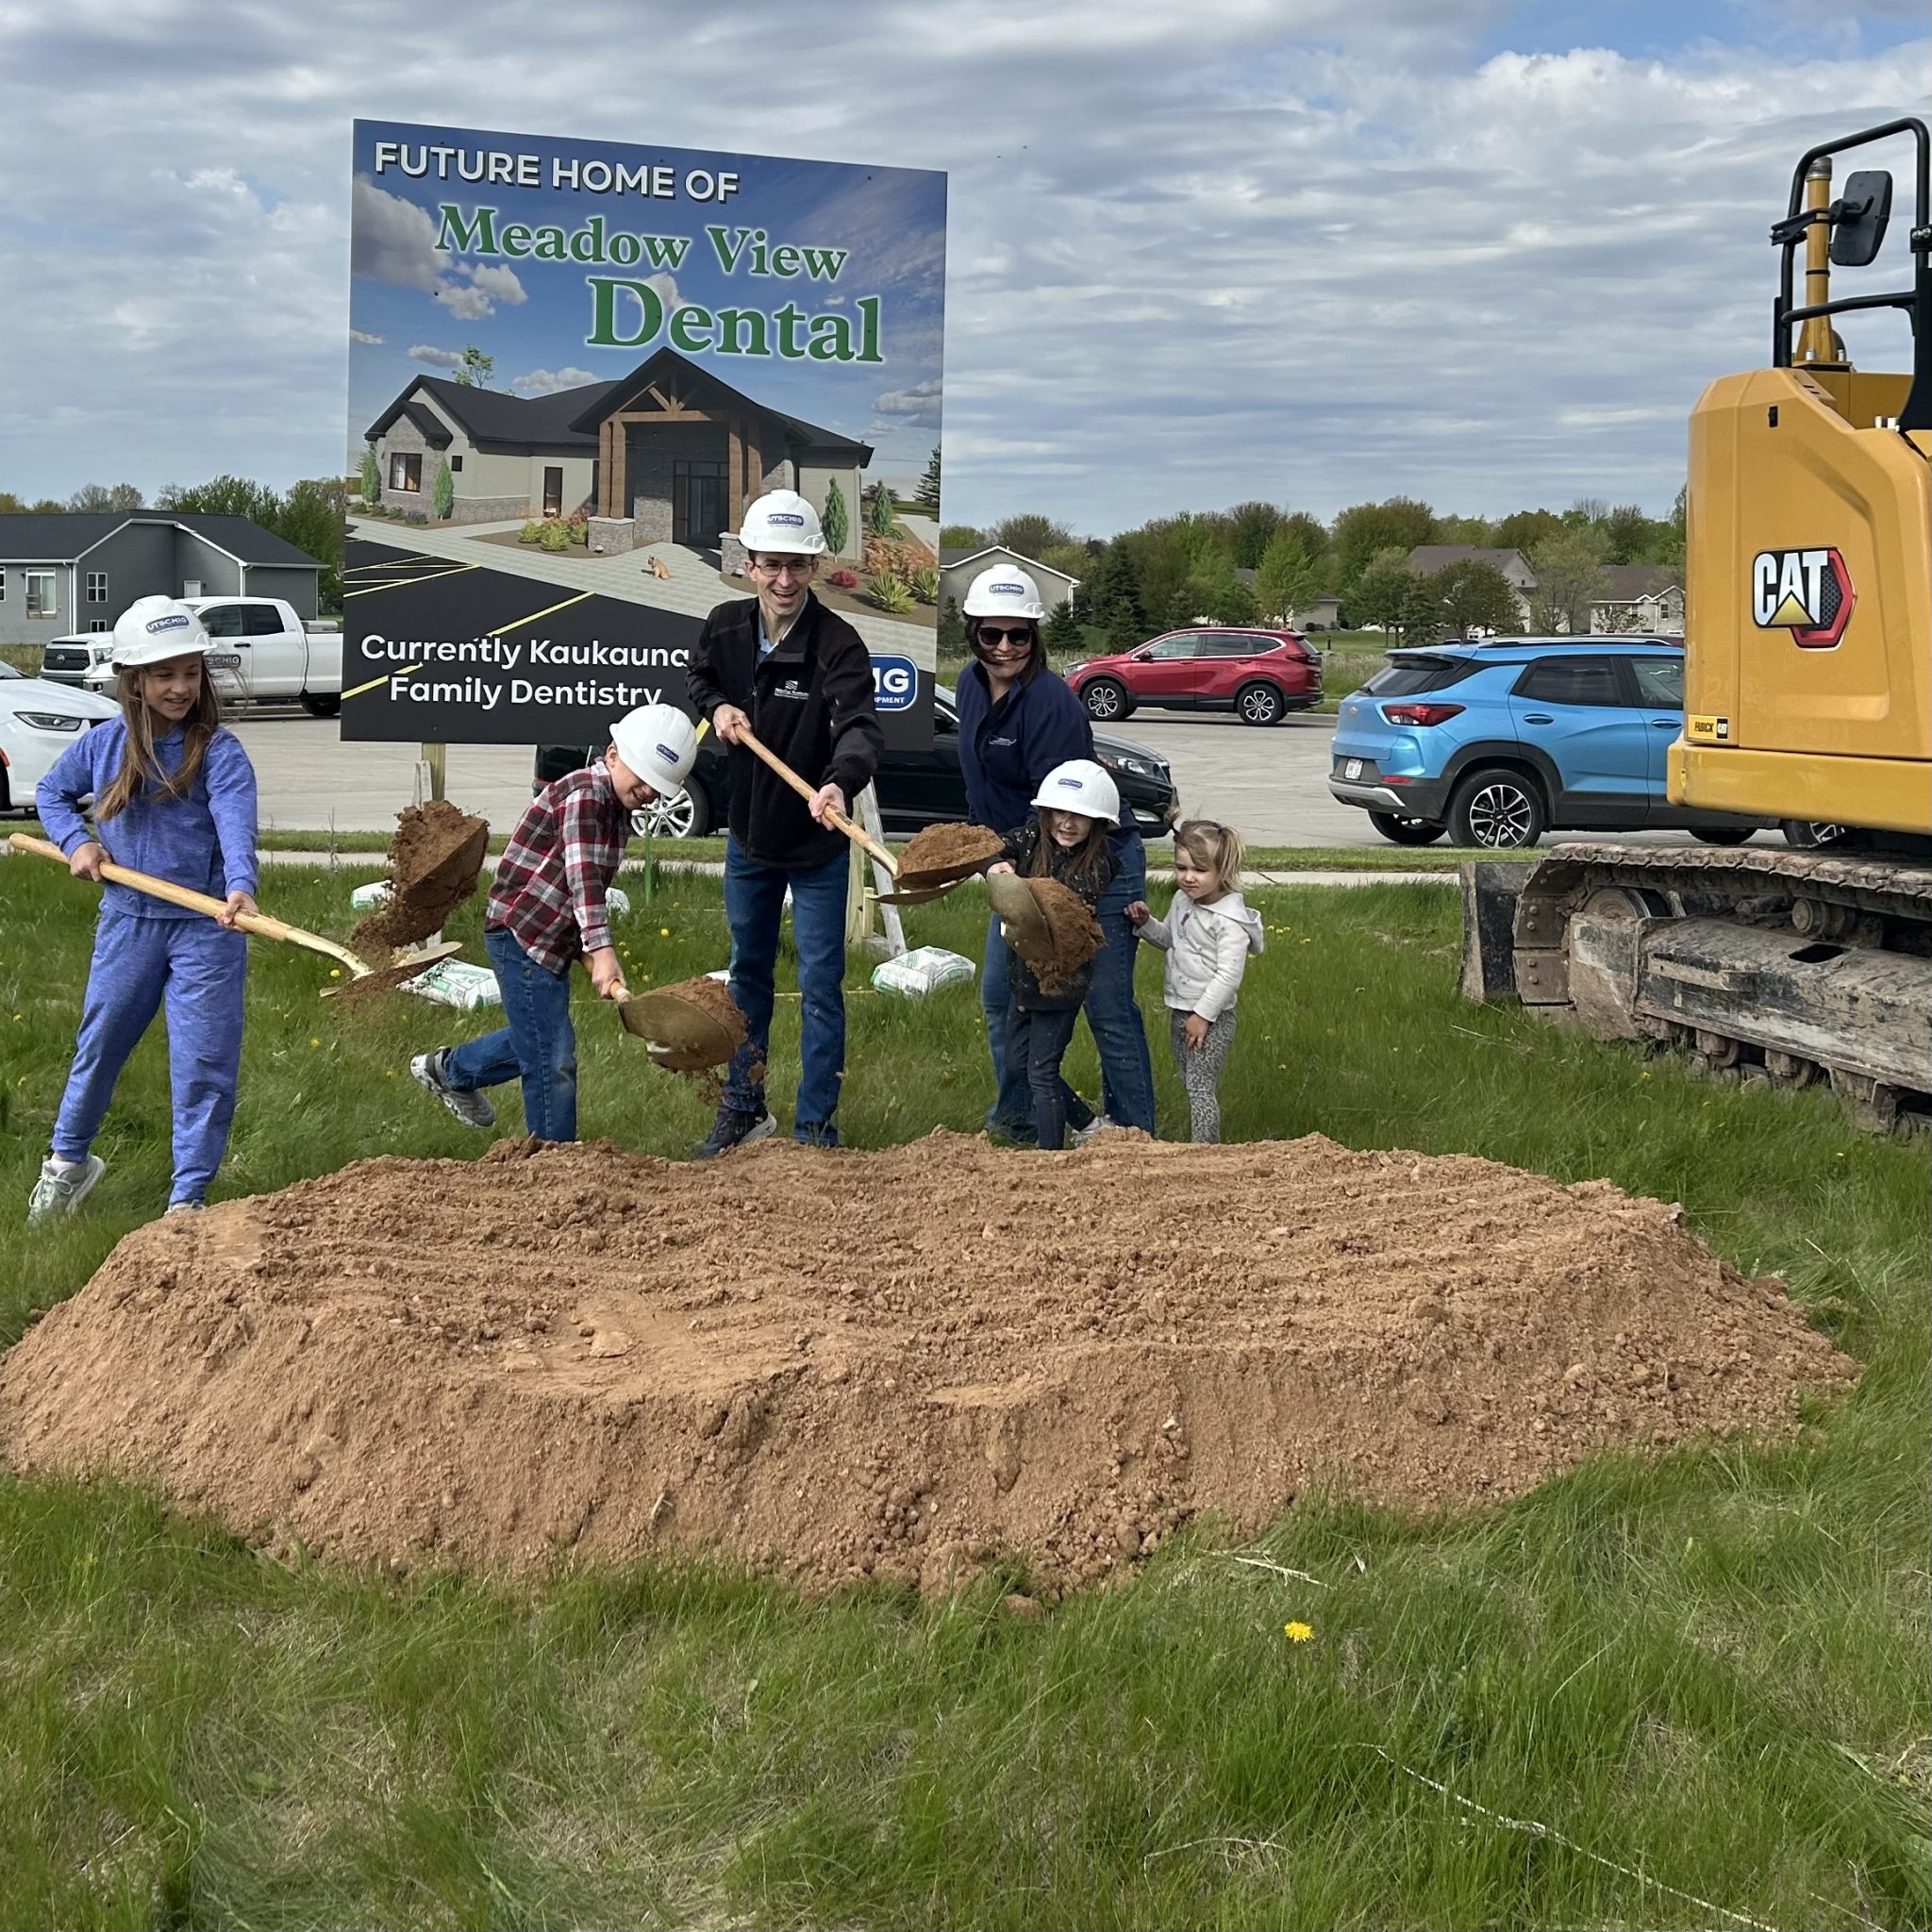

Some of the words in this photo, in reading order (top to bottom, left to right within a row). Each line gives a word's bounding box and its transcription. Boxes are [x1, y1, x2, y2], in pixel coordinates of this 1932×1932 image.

[375, 142, 541, 186] FUTURE
[552, 158, 676, 198] HOME
[685, 170, 740, 203] OF
[434, 205, 690, 269] Meadow
[707, 226, 847, 280] View
[587, 277, 883, 362] Dental
[1754, 550, 1828, 625] CAT
[360, 635, 521, 670] Currently
[529, 639, 690, 668] Kaukauna
[390, 676, 502, 709] Family
[510, 679, 662, 706] Dentistry
